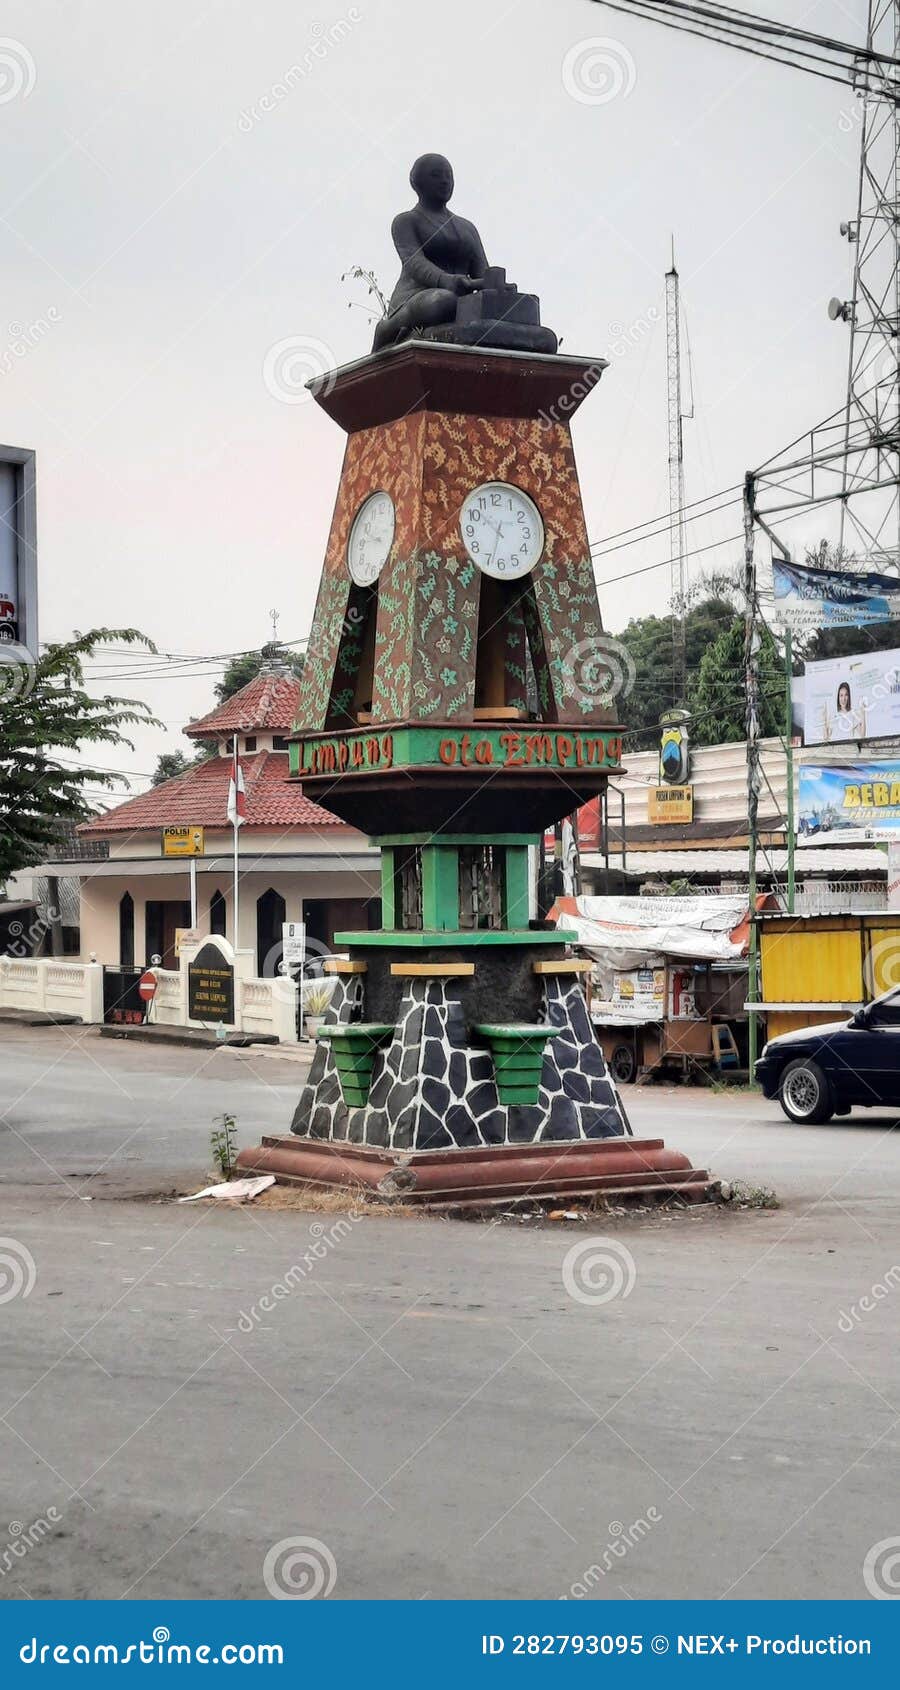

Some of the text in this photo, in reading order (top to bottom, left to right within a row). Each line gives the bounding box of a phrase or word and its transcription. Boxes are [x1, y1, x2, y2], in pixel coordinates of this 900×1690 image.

[478, 497, 487, 510] 11
[490, 493, 502, 506] 12
[508, 499, 513, 511] 1
[468, 508, 481, 522] 10
[517, 510, 526, 524] 2
[465, 524, 475, 538] 9
[522, 527, 531, 540] 3
[471, 541, 480, 554] 8
[519, 542, 529, 556] 4
[485, 553, 493, 567] 7
[497, 558, 506, 571] 6
[510, 554, 520, 567] 5
[164, 827, 190, 836] POLISI
